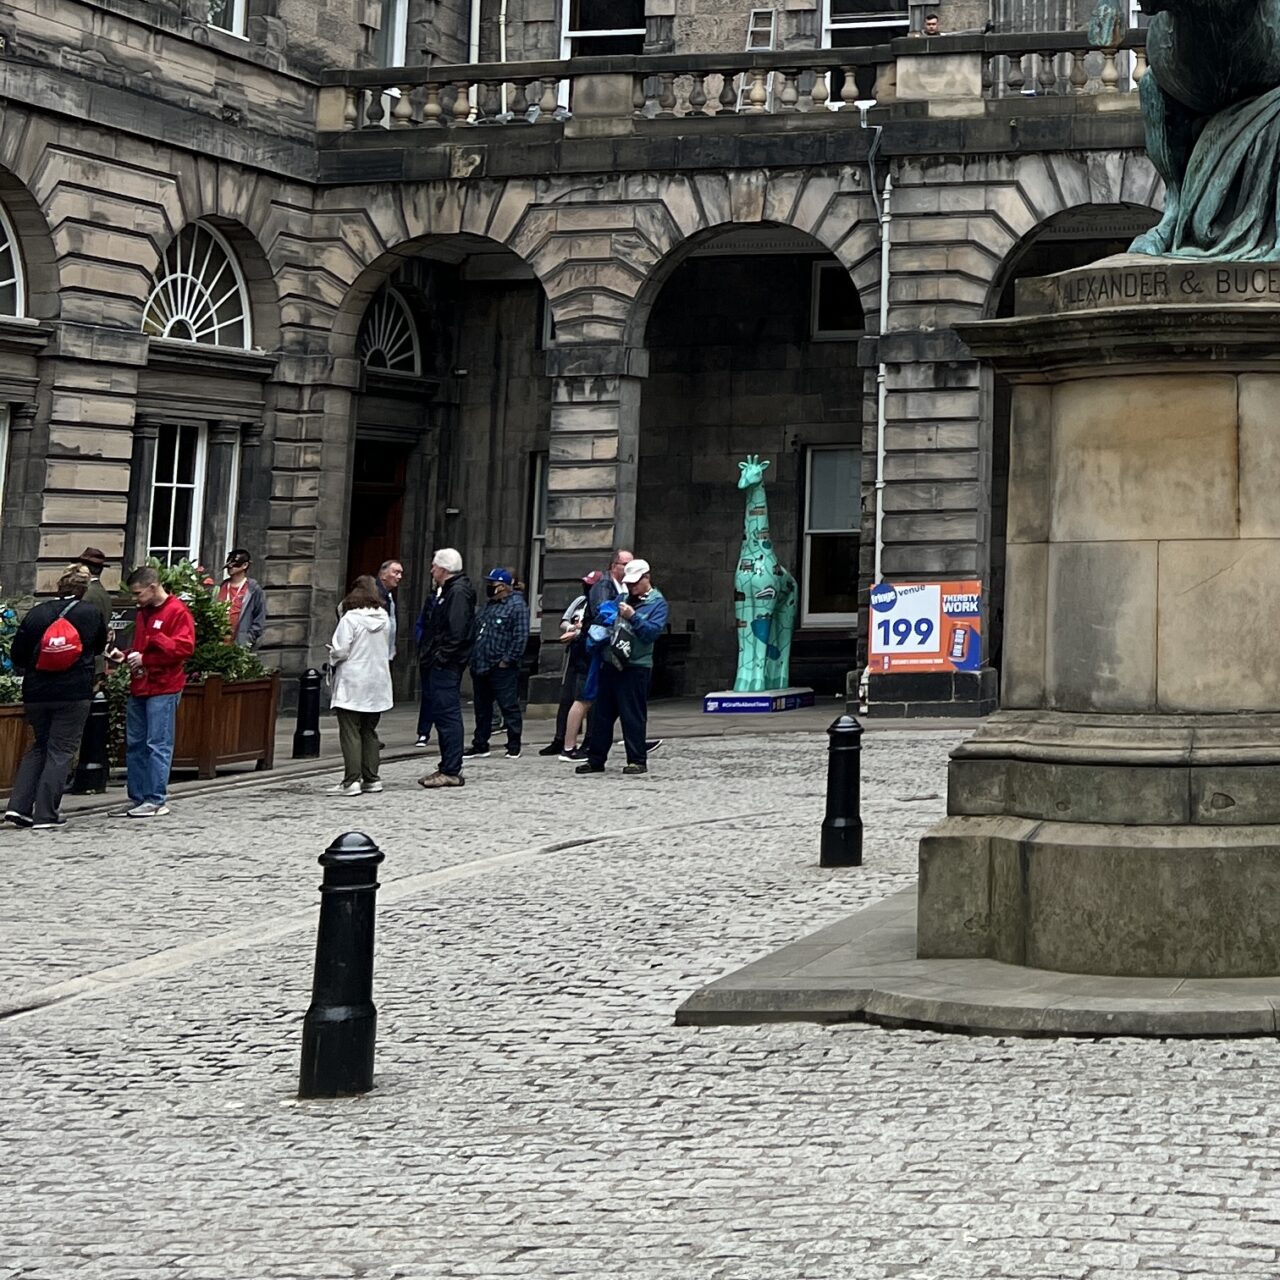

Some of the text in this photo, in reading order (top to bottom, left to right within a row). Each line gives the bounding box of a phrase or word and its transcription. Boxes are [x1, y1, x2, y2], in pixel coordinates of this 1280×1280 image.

[1063, 271, 1169, 304] ALEXANDER
[1180, 270, 1204, 295] &
[871, 585, 926, 605] fringe venue
[943, 594, 979, 602] THIRSTY
[943, 602, 979, 613] WORK
[877, 618, 934, 646] 199
